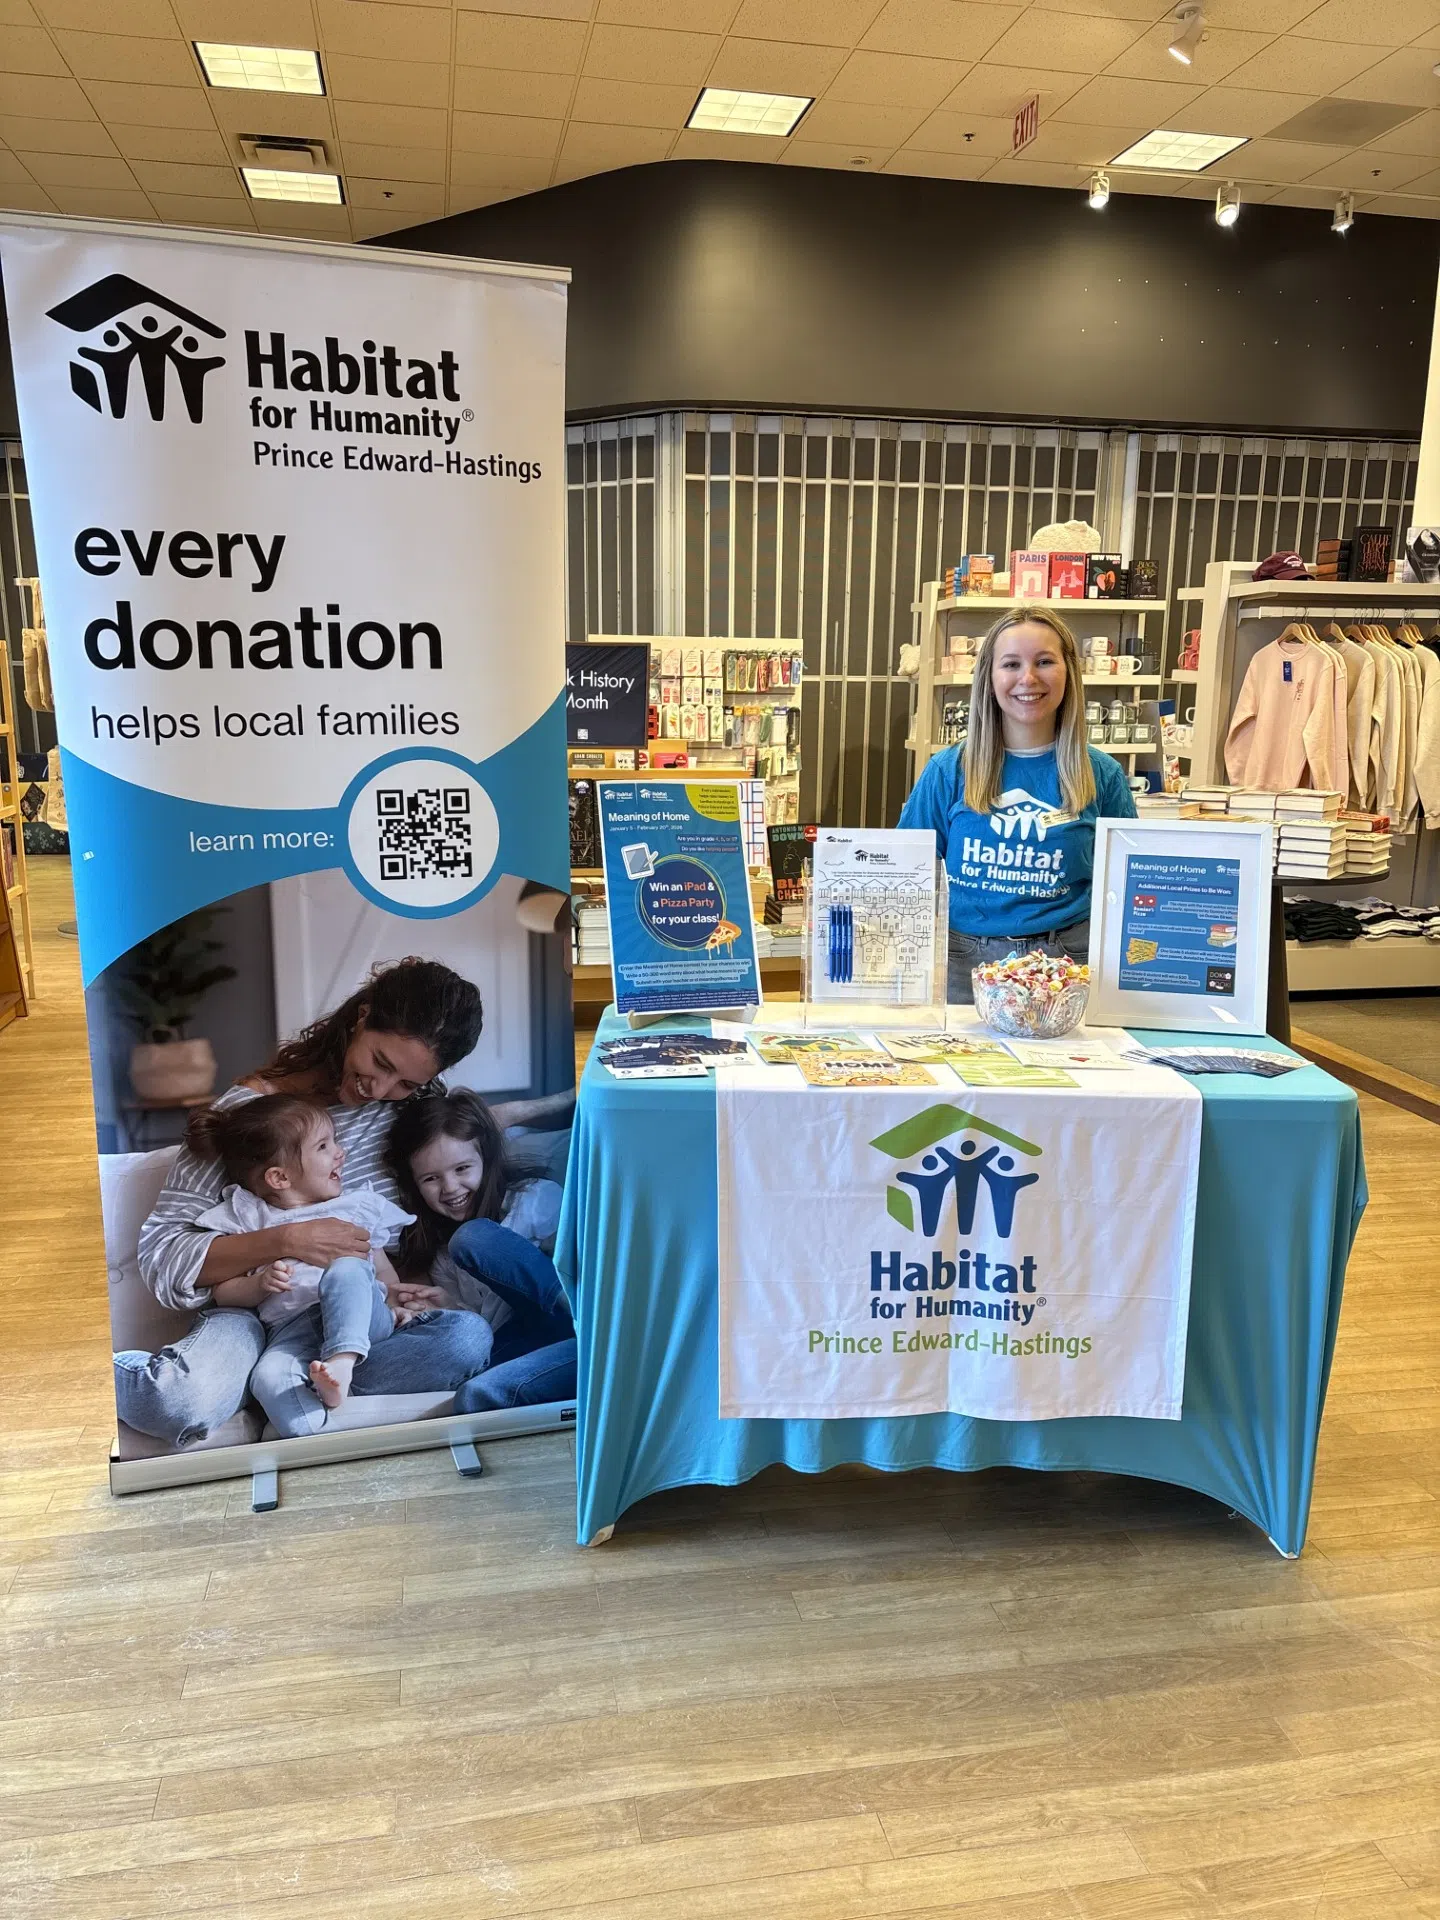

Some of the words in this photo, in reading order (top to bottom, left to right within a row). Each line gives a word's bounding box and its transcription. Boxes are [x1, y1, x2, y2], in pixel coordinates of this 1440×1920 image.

[1013, 99, 1035, 150] EXIT
[244, 329, 460, 402] Habitat
[249, 396, 297, 429] for
[253, 441, 334, 469] Prince
[343, 445, 542, 484] Edward-Hastings
[74, 527, 286, 593] every
[1019, 554, 1047, 563] PARIS
[1055, 554, 1084, 562] LONDON
[84, 600, 443, 670] donation
[580, 670, 635, 694] History
[91, 705, 200, 746] helps
[214, 704, 304, 738] local
[316, 703, 460, 736] families
[608, 812, 650, 823] Meaning
[651, 811, 661, 821] of
[662, 811, 690, 821] Home
[189, 831, 254, 853] learn
[262, 830, 335, 850] more:
[962, 836, 1064, 870] Habitat
[961, 862, 982, 876] for
[1130, 862, 1168, 873] Meaning
[1180, 865, 1207, 874] Home
[649, 882, 669, 892] Win
[684, 881, 706, 891] iPad
[707, 882, 716, 891] &
[652, 900, 659, 908] a
[660, 898, 688, 908] Pizza
[689, 898, 715, 909] Party
[652, 915, 667, 924] for
[668, 916, 691, 926] your
[691, 913, 720, 924] class!
[825, 1061, 897, 1069] HOME
[870, 1249, 1038, 1293] Habitat
[869, 1296, 906, 1319] for
[808, 1330, 883, 1354] Prince
[892, 1329, 1092, 1359] Edward-Hastings
